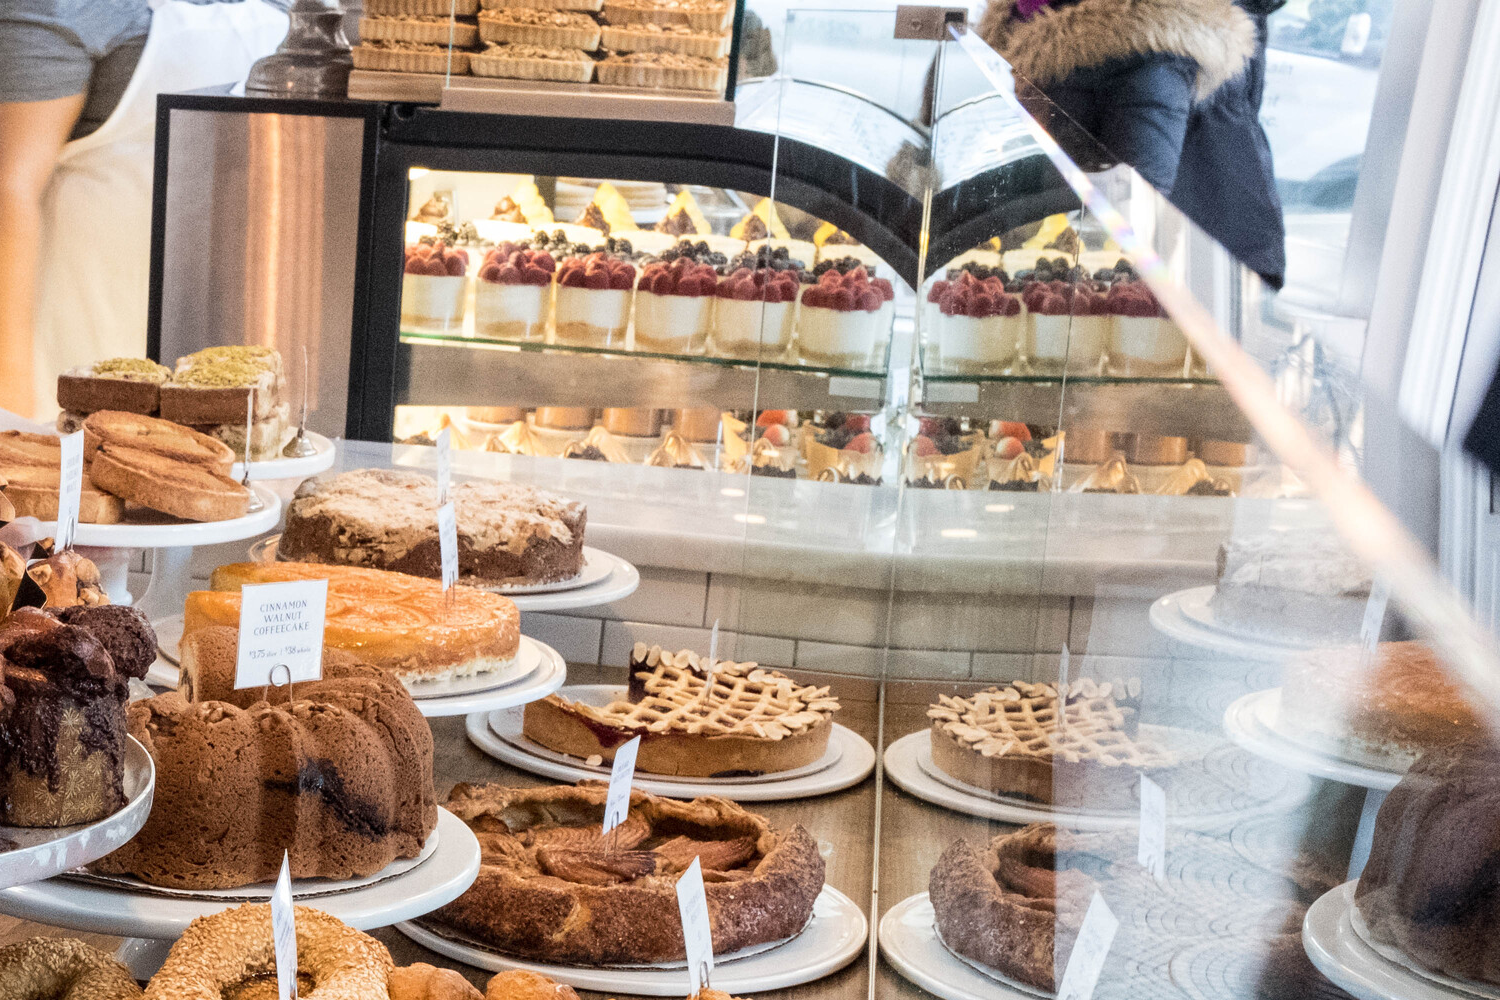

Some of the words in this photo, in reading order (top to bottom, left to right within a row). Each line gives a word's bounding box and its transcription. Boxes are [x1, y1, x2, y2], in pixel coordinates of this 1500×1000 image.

[259, 599, 307, 613] CINNAMON
[263, 611, 302, 623] WALNUT
[253, 621, 310, 636] COFFEECAKE
